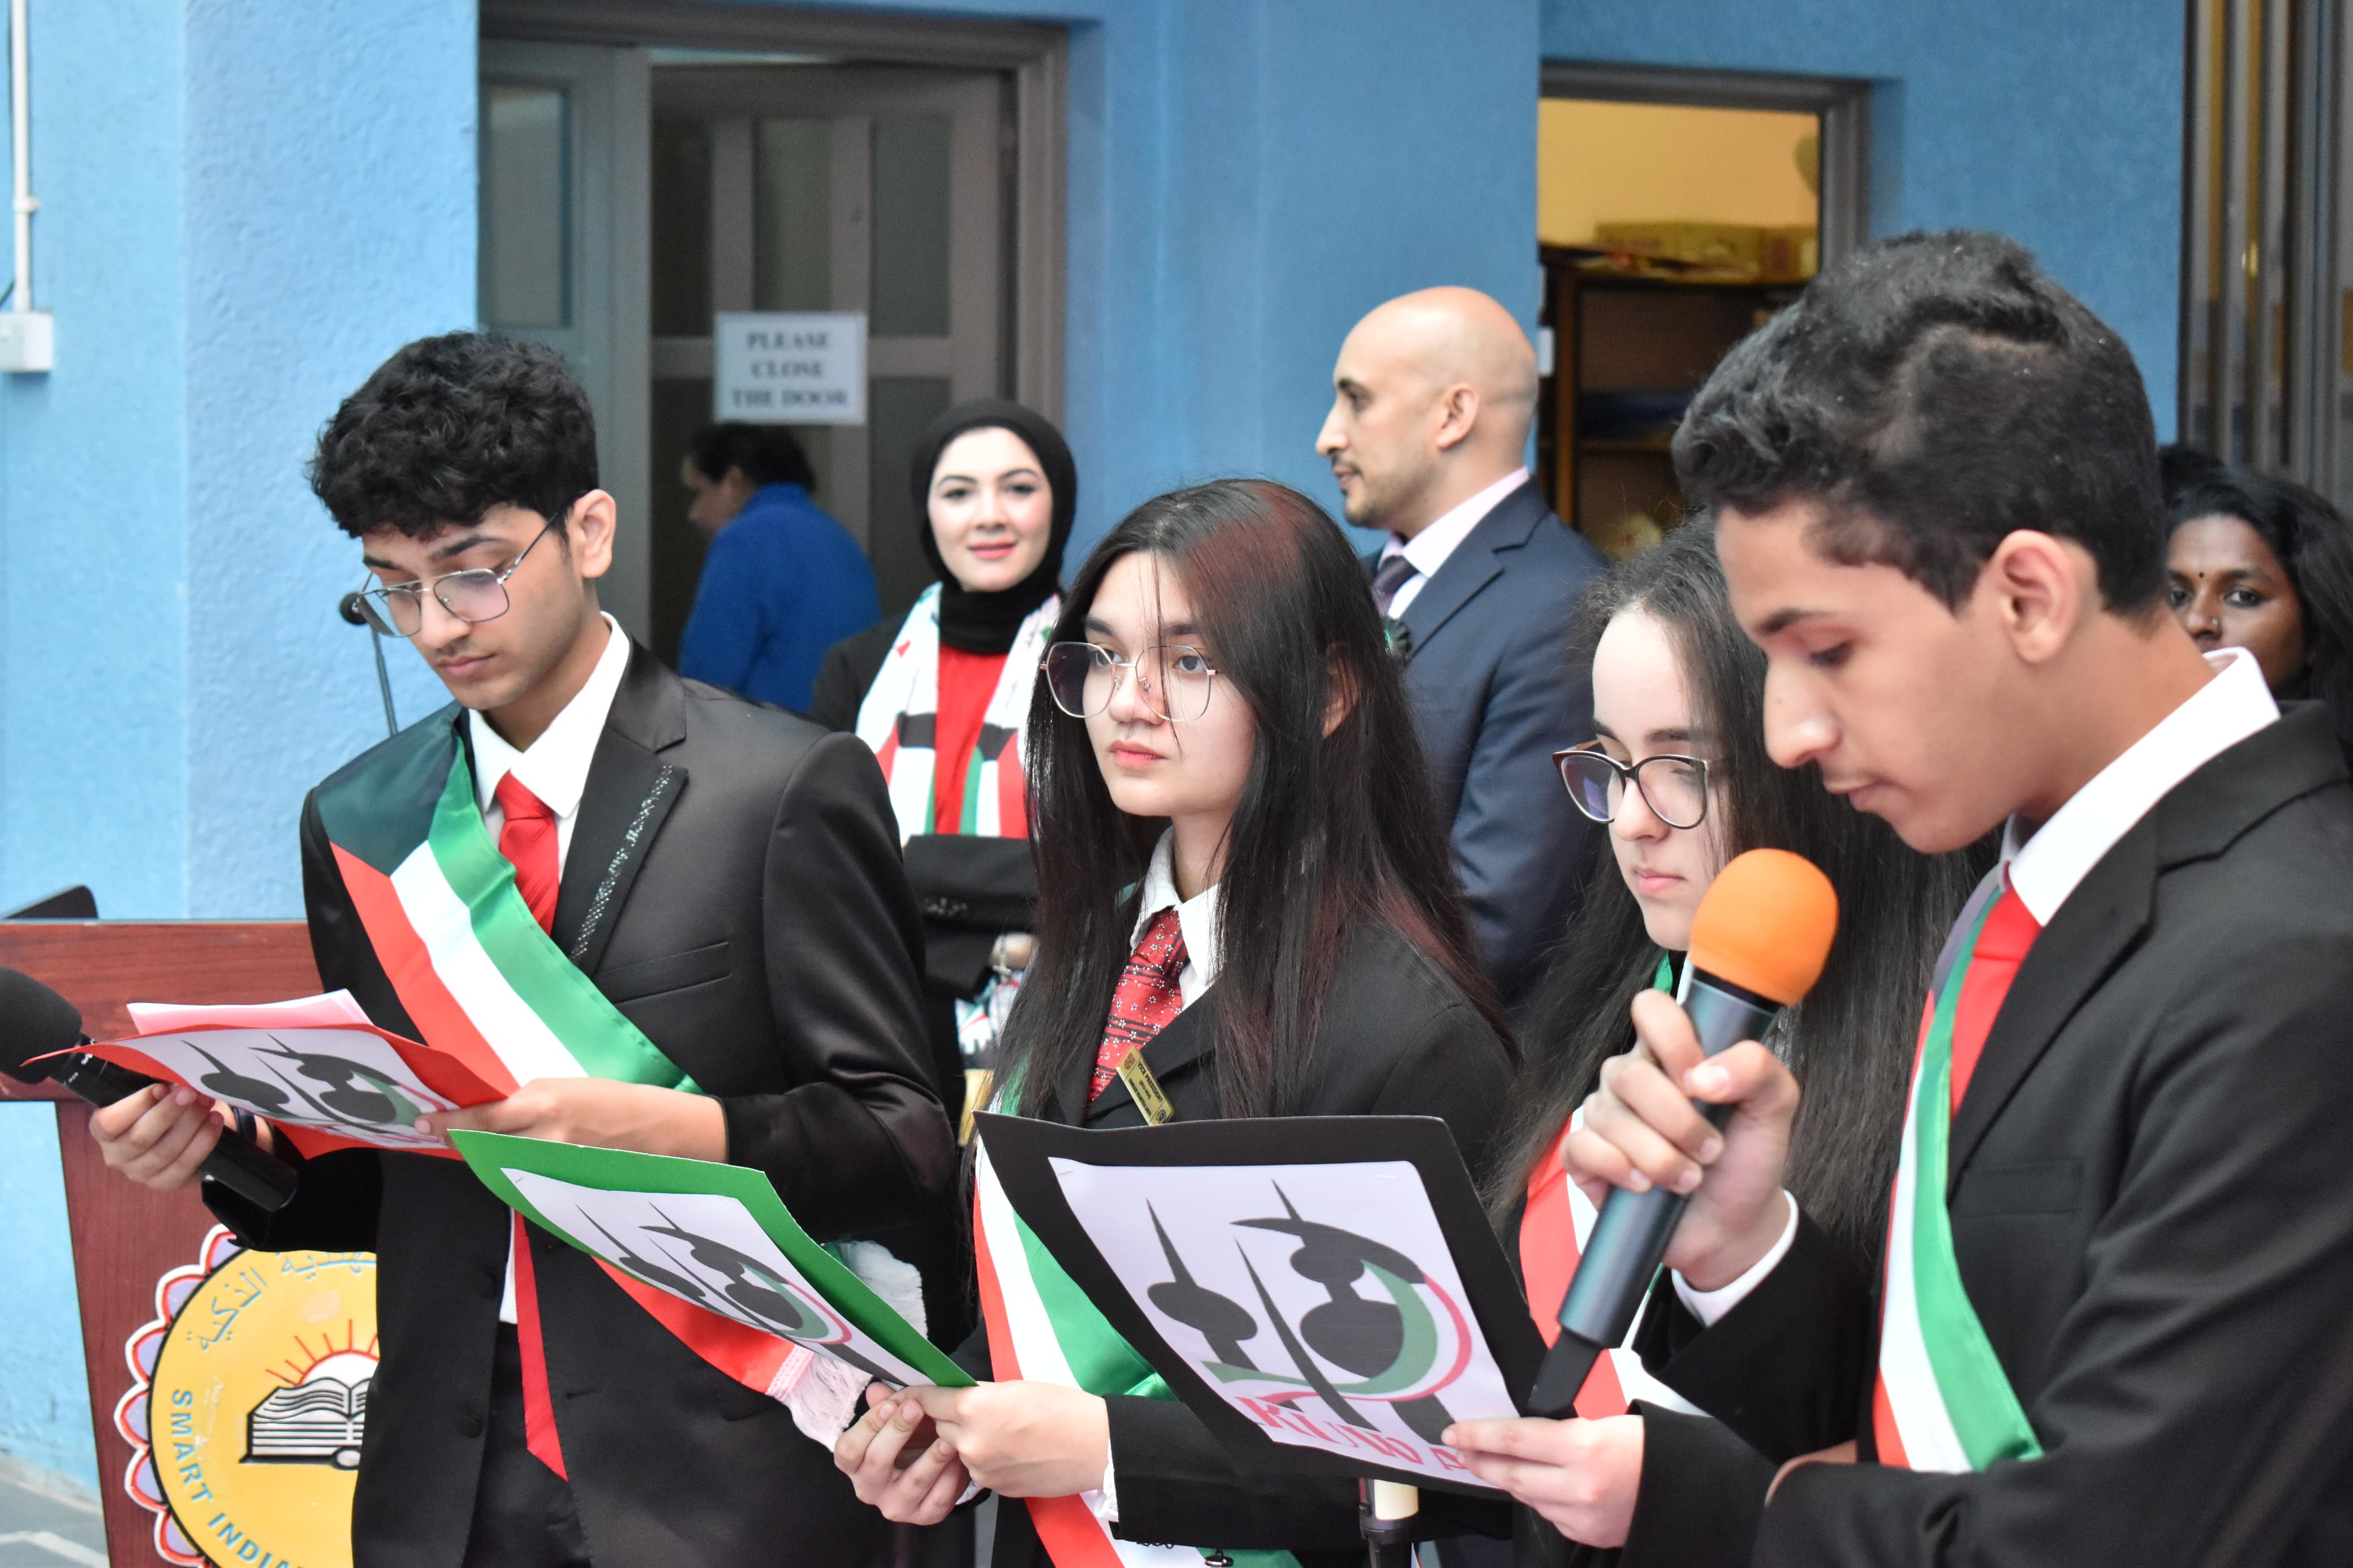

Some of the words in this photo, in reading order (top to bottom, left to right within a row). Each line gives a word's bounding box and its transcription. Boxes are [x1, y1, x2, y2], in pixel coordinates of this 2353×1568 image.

[747, 332, 828, 349] PLEASE
[751, 361, 822, 378] CLOSE
[732, 389, 772, 406] THE
[781, 388, 847, 405] DOOR
[1137, 1061, 1147, 1075] VICE
[1145, 1073, 1163, 1103] PRESIDENT
[171, 1389, 214, 1502] SMART
